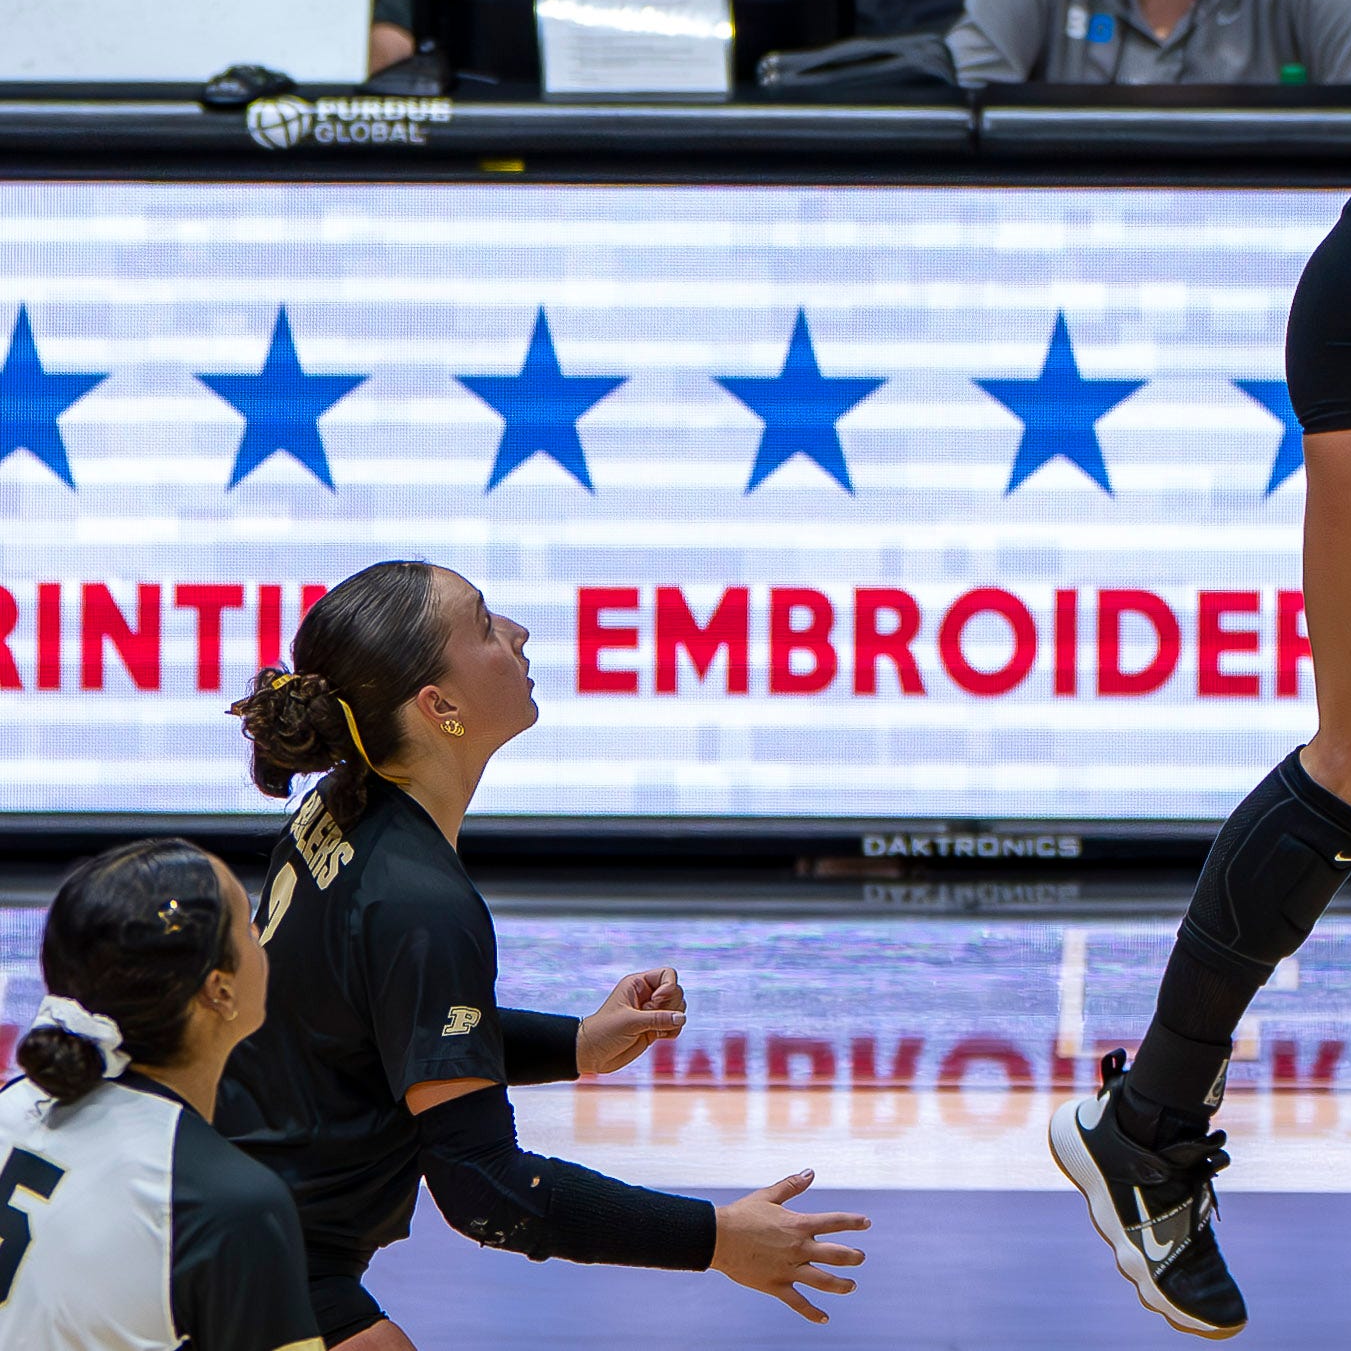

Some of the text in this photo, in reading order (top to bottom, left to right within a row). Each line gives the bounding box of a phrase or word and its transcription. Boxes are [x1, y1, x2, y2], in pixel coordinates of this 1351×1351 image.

[314, 96, 452, 122] PURDUE
[313, 121, 425, 146] GLOBAL
[862, 835, 1084, 859] DAKTRONICS
[441, 1005, 482, 1037] P
